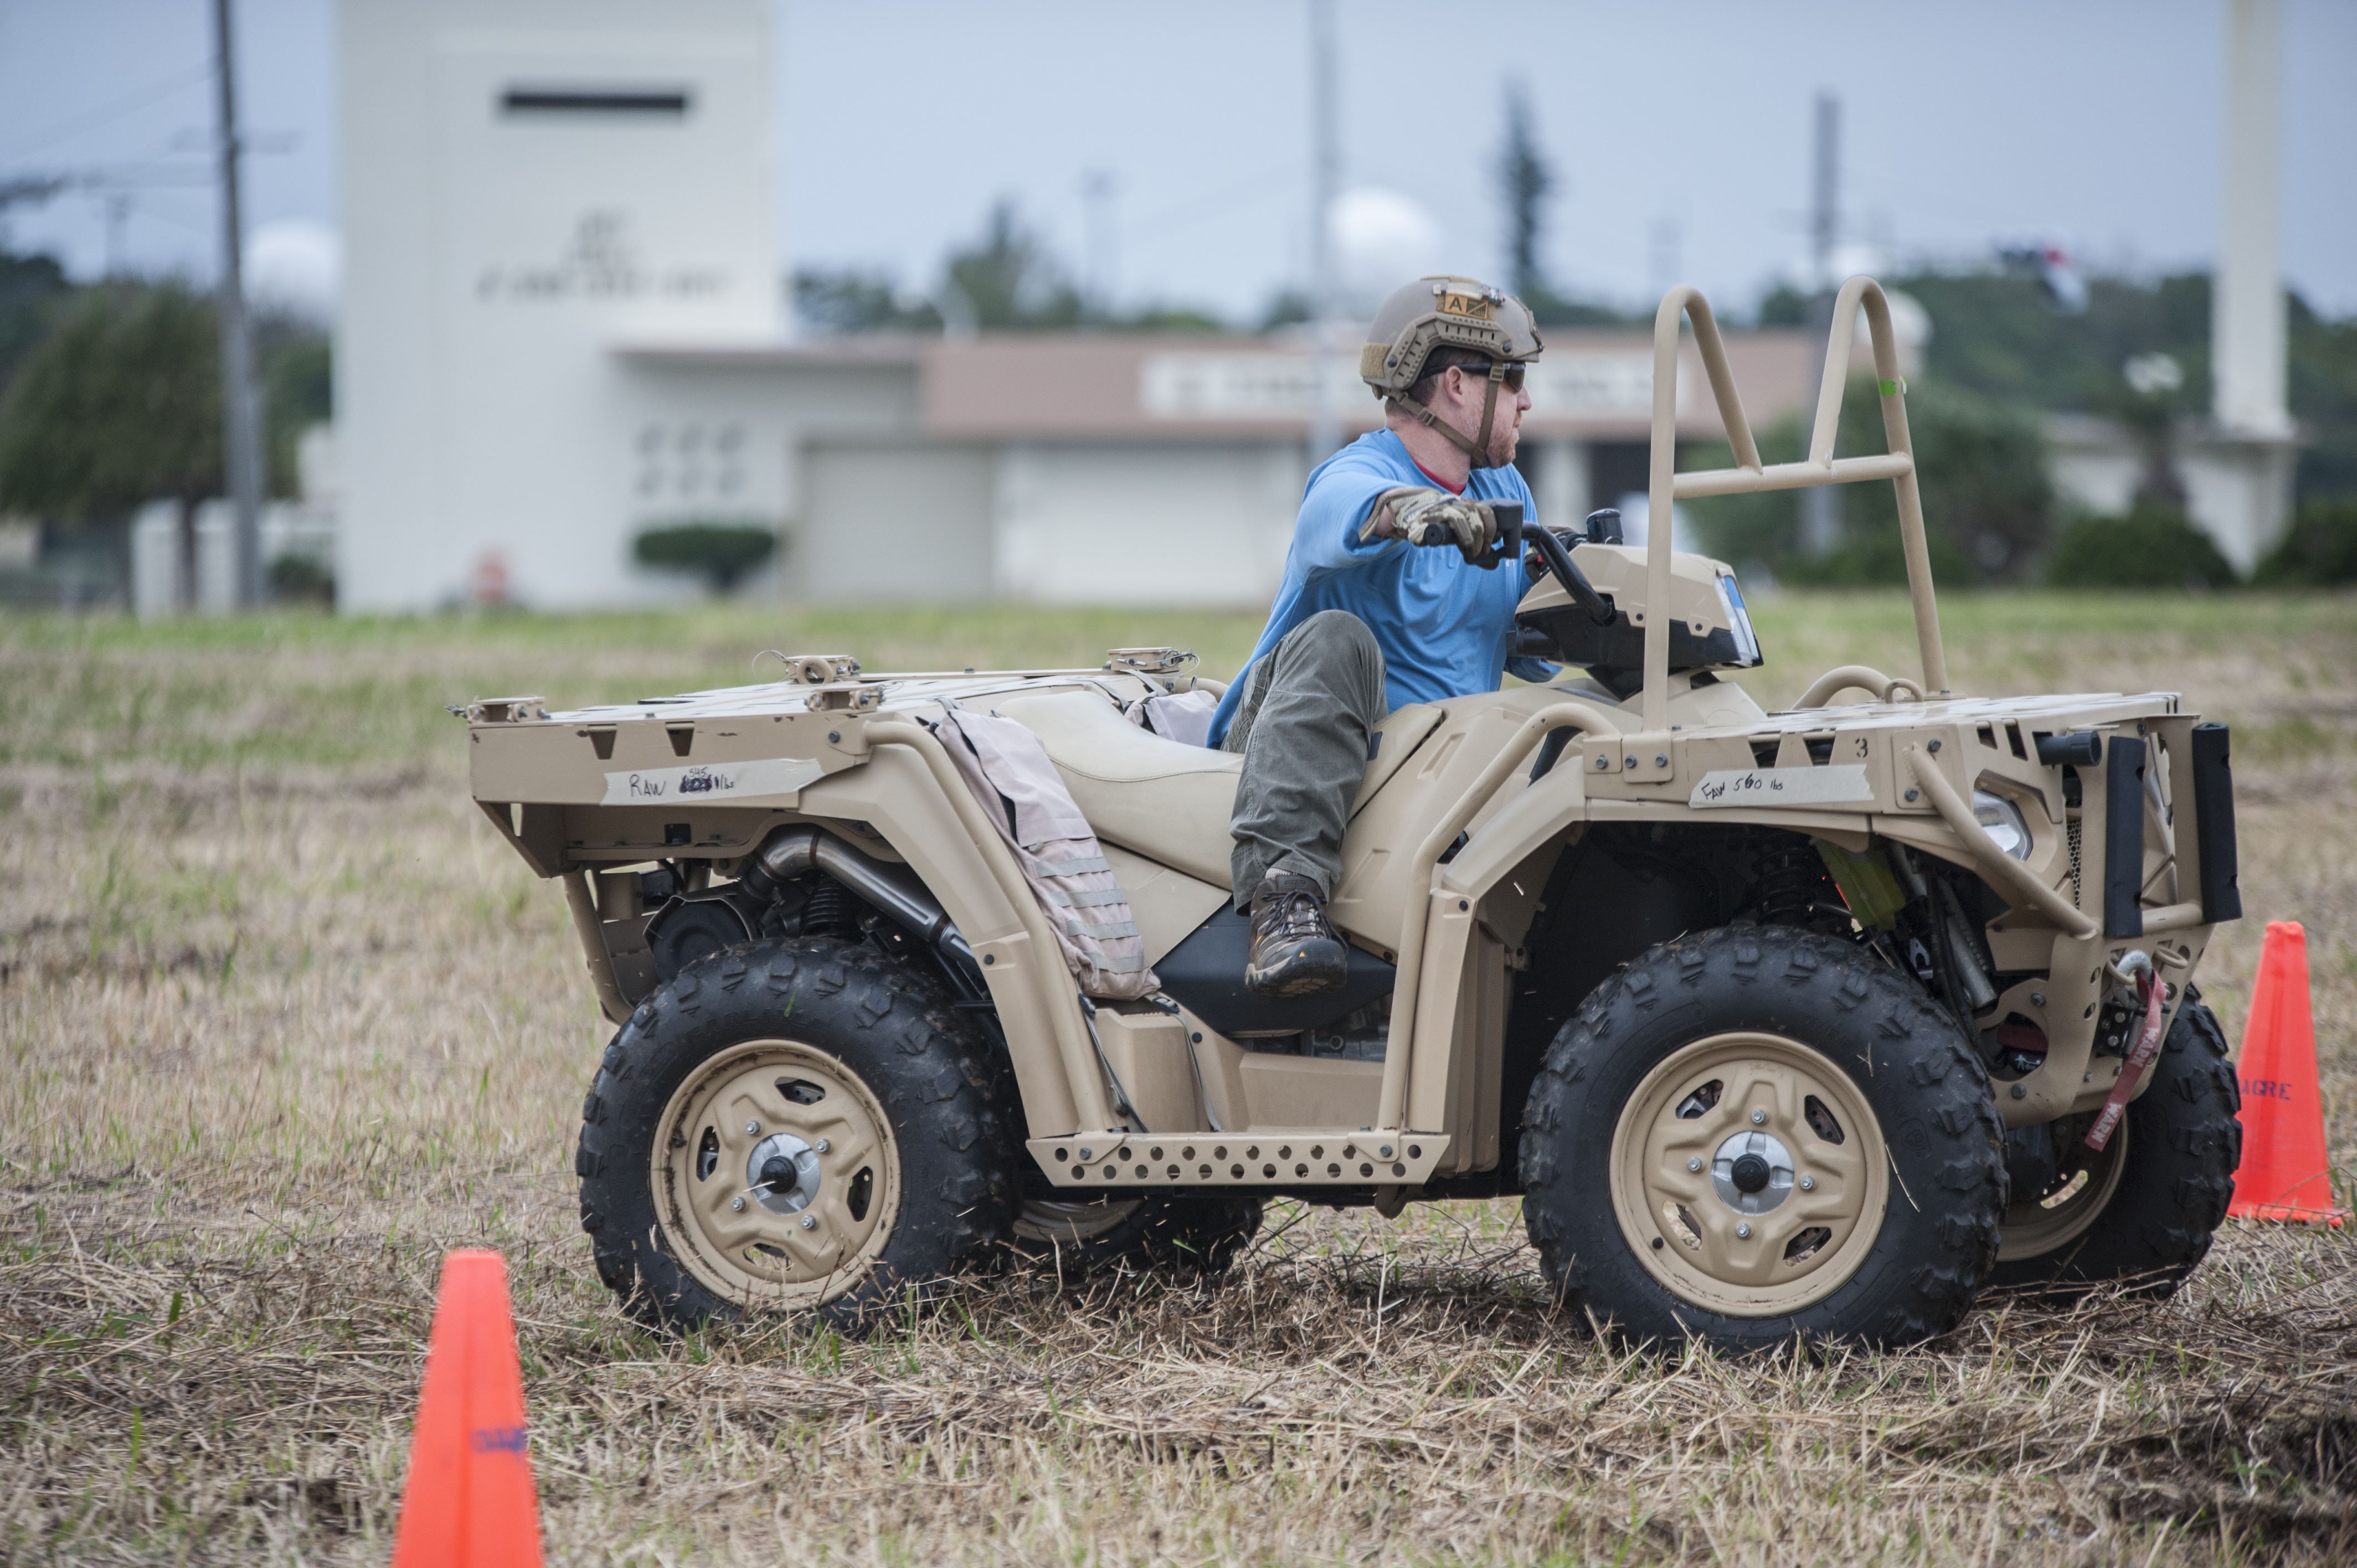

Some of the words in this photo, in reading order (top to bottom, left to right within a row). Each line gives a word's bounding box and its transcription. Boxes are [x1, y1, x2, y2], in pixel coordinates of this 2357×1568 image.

[1449, 297, 1463, 311] A
[1855, 737, 1868, 758] 3
[629, 774, 666, 797] RAW
[2130, 1028, 2159, 1068] WARN
[2091, 1103, 2122, 1144] WARN
